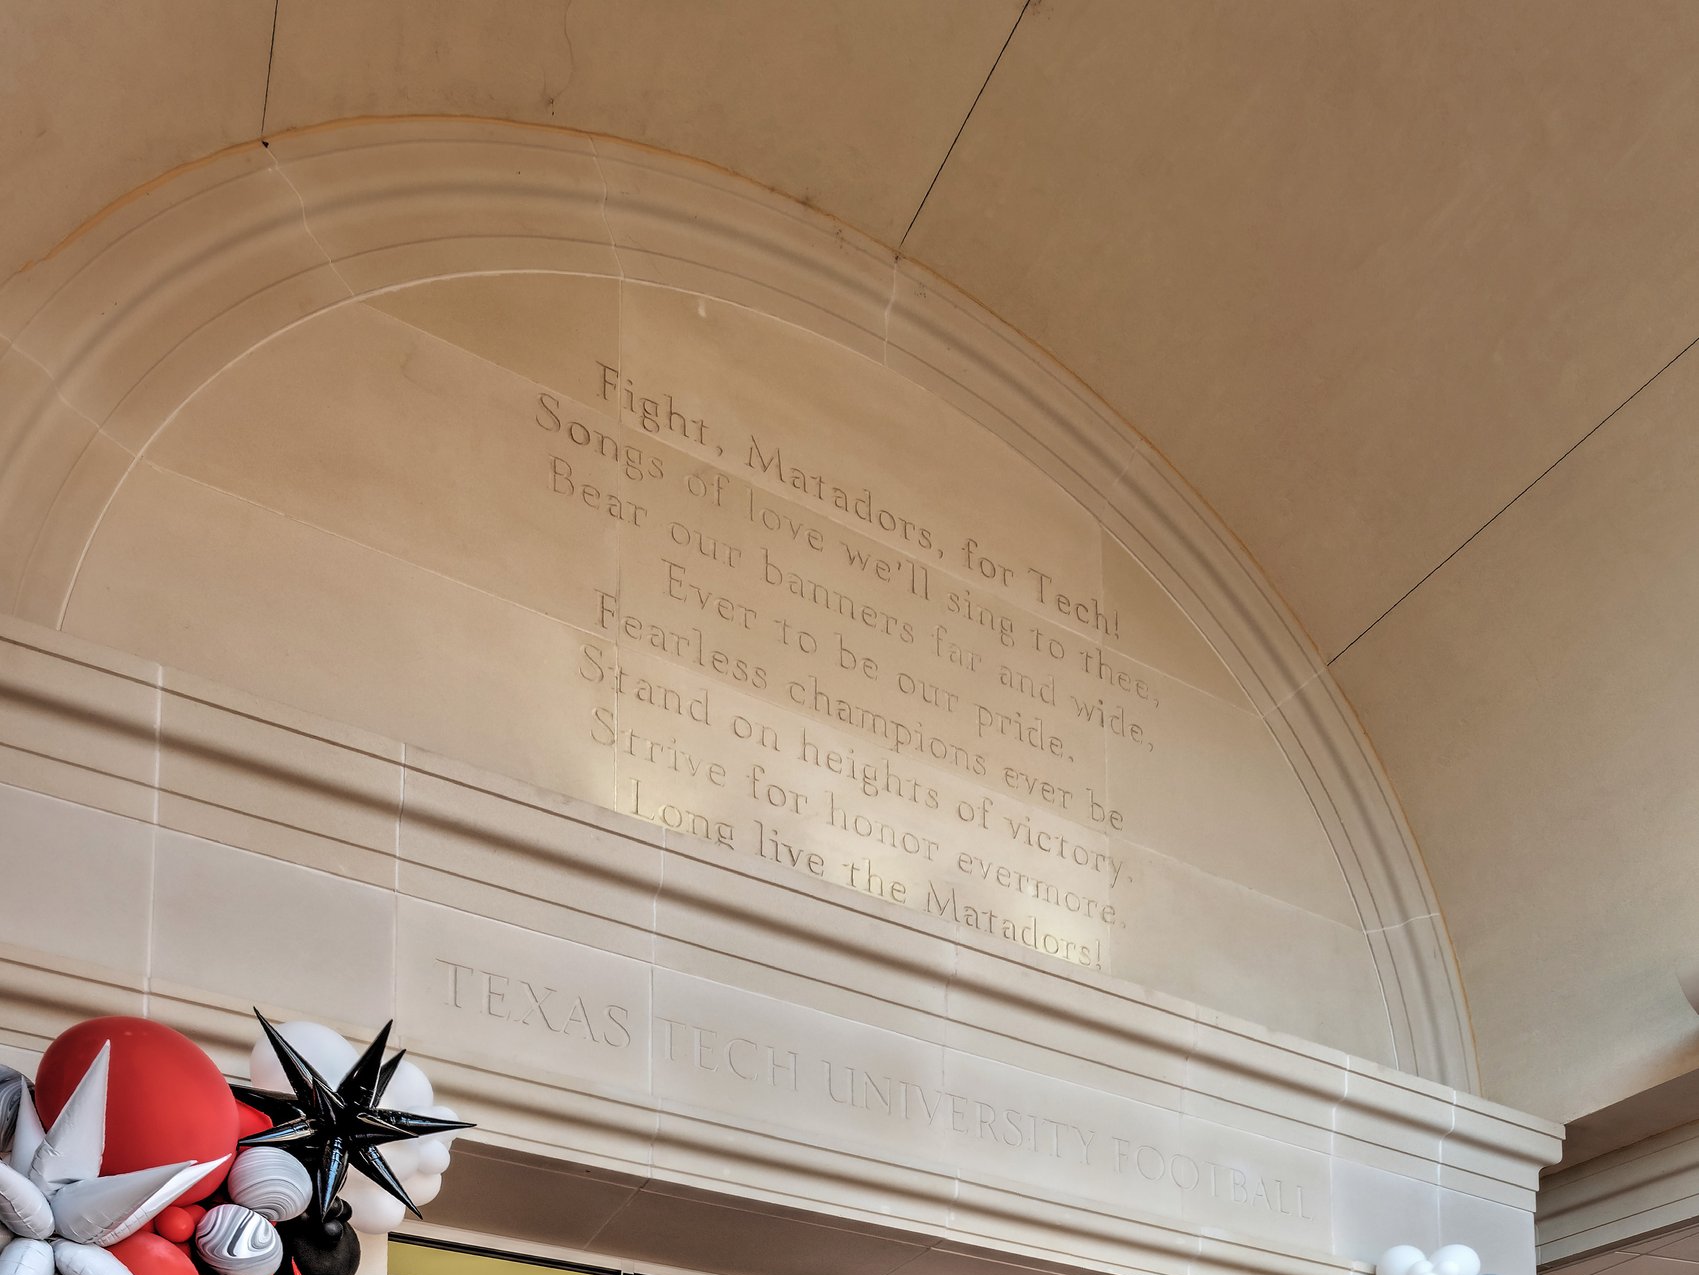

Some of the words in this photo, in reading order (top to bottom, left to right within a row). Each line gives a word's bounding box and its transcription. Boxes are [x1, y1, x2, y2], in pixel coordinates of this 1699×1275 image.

[535, 392, 664, 481] Songs
[687, 472, 730, 507] of
[746, 486, 824, 552] love
[841, 541, 929, 601] we'll
[948, 590, 1015, 647] sing
[1030, 628, 1065, 659] to
[1080, 648, 1159, 708] thee,
[548, 455, 648, 527] Bear
[670, 521, 742, 568] our
[760, 547, 914, 644] banners
[931, 625, 982, 672] far
[999, 666, 1056, 707] and
[1071, 696, 1154, 752] wide,
[596, 361, 723, 457] Fight,
[745, 435, 944, 559] Matadors,
[961, 538, 1014, 588] for
[1028, 567, 1119, 639] Tech!
[579, 643, 711, 726] Stand
[733, 715, 781, 752] on
[798, 727, 939, 810] heights
[957, 796, 993, 829] of
[1003, 816, 1133, 889] victory.
[594, 588, 768, 689] Fearless
[788, 675, 988, 776] champions
[1004, 766, 1073, 809] ever
[1086, 788, 1124, 831] be
[661, 558, 757, 630] Ever
[774, 618, 817, 654] to
[835, 632, 878, 680] be
[898, 672, 959, 712] our
[973, 702, 1074, 762] pride.
[591, 707, 726, 787] Strive
[746, 765, 808, 815] for
[824, 790, 939, 862] honor
[957, 852, 1126, 929] evermore.
[629, 777, 735, 850] Long
[753, 819, 825, 877] live
[842, 857, 907, 904] the
[923, 880, 1102, 970] Matadors!
[434, 958, 631, 1049] TEXAS
[655, 1016, 799, 1092] TECH
[820, 1060, 1096, 1166] UNIVERSITY
[1111, 1136, 1313, 1221] FOOTBALL
